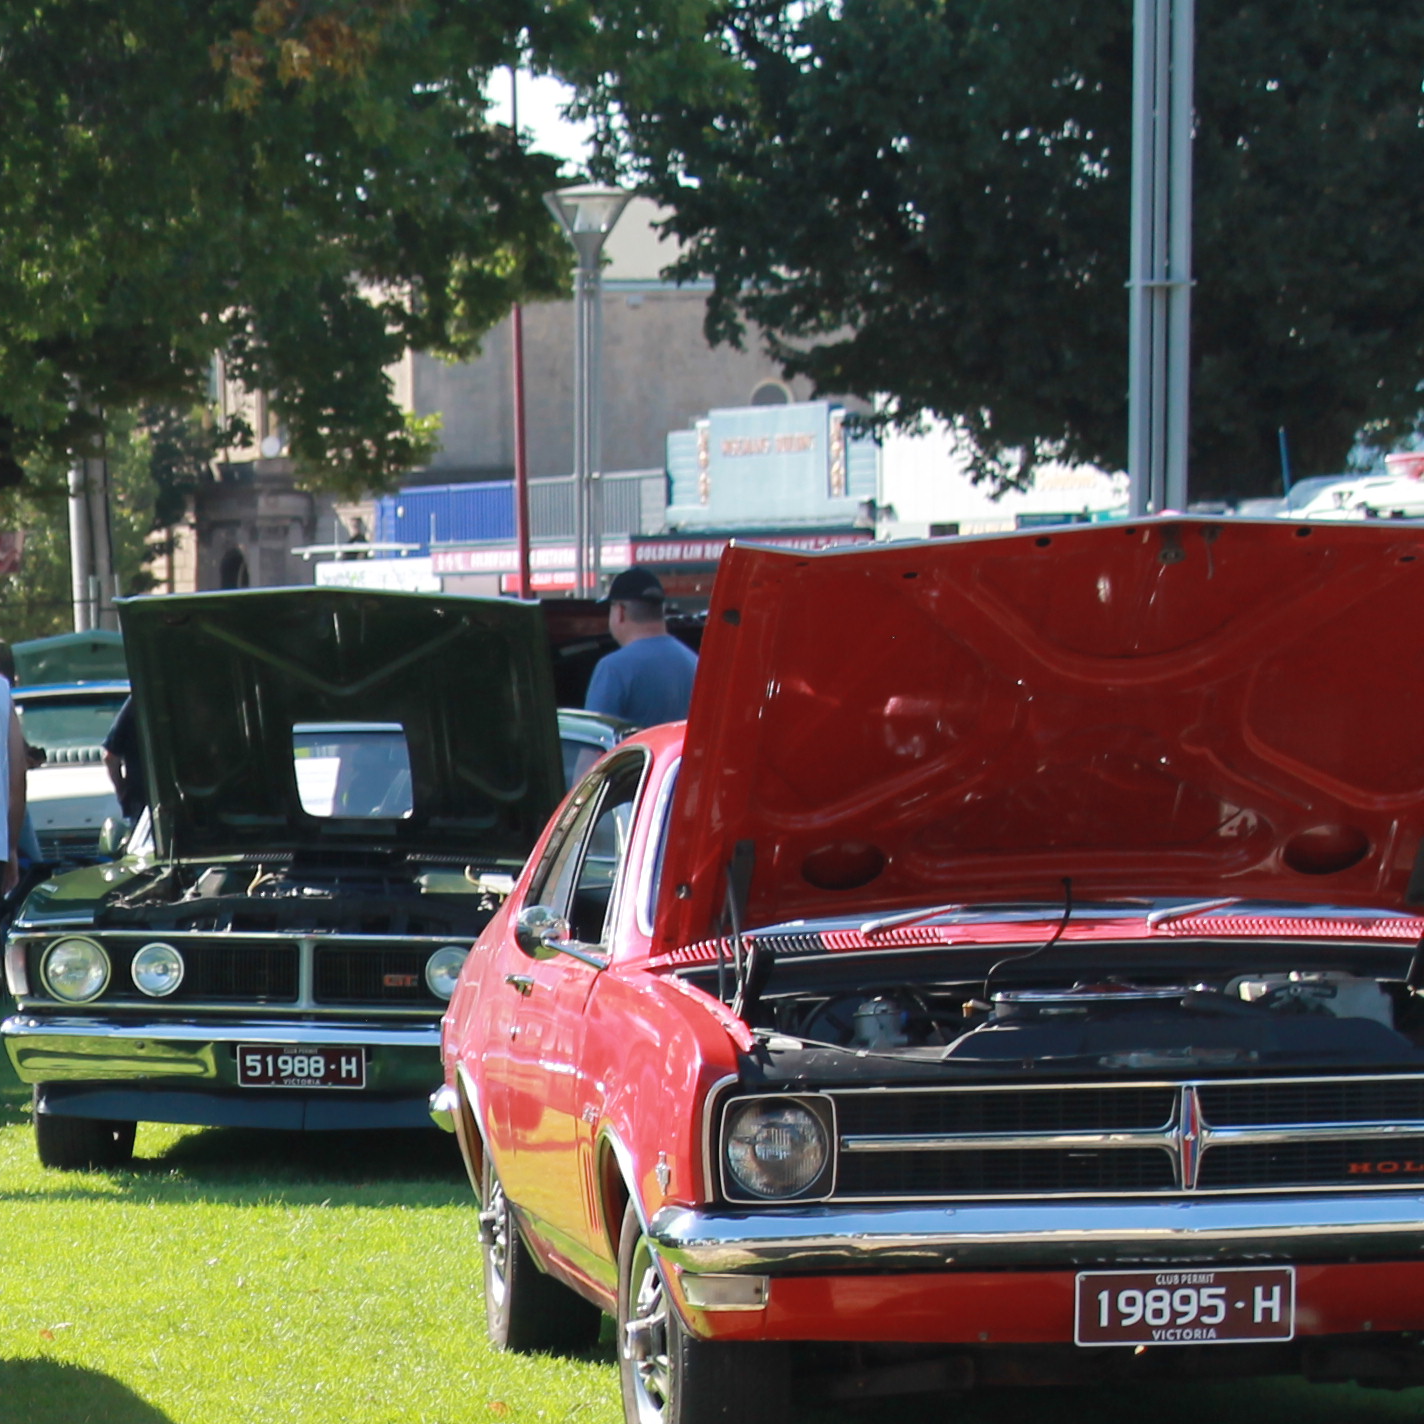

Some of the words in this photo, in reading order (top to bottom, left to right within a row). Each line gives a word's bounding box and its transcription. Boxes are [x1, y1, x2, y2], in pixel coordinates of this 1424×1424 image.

[283, 1078, 321, 1086] VICTORIA
[1155, 1273, 1180, 1285] CLUB
[1181, 1272, 1216, 1284] PERMIT
[1152, 1327, 1217, 1341] VICTORIA
